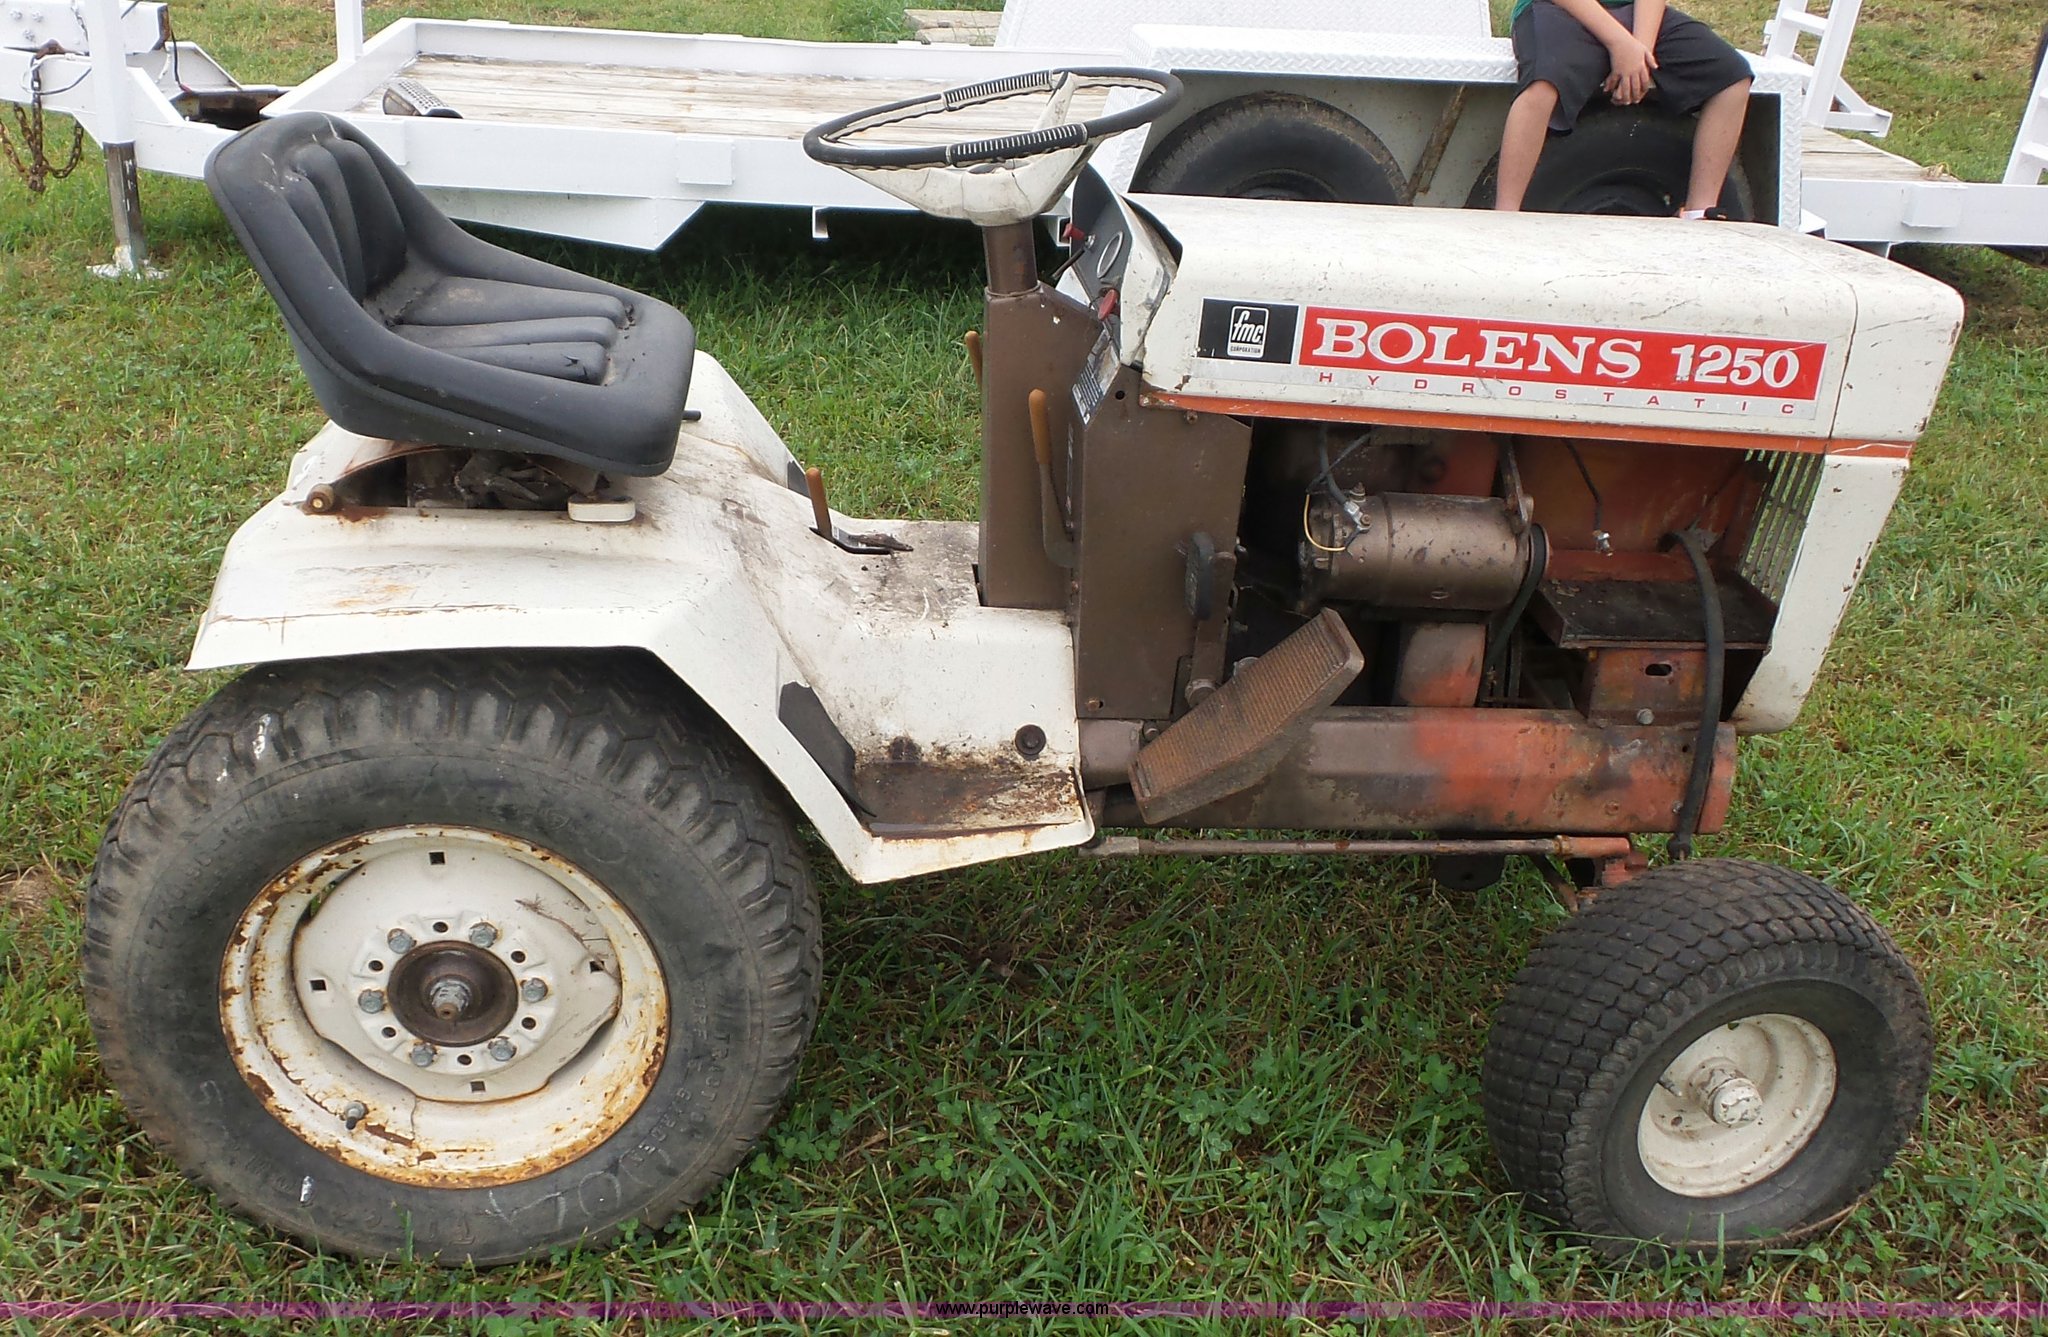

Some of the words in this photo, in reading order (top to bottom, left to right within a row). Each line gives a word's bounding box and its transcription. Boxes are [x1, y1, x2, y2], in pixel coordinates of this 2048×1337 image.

[1231, 310, 1264, 343] fmc
[1230, 345, 1261, 354] CORPORATION
[1312, 317, 1643, 379] BOLENS
[1671, 343, 1801, 388] 1250
[1318, 371, 1795, 416] HYDROSTATIC
